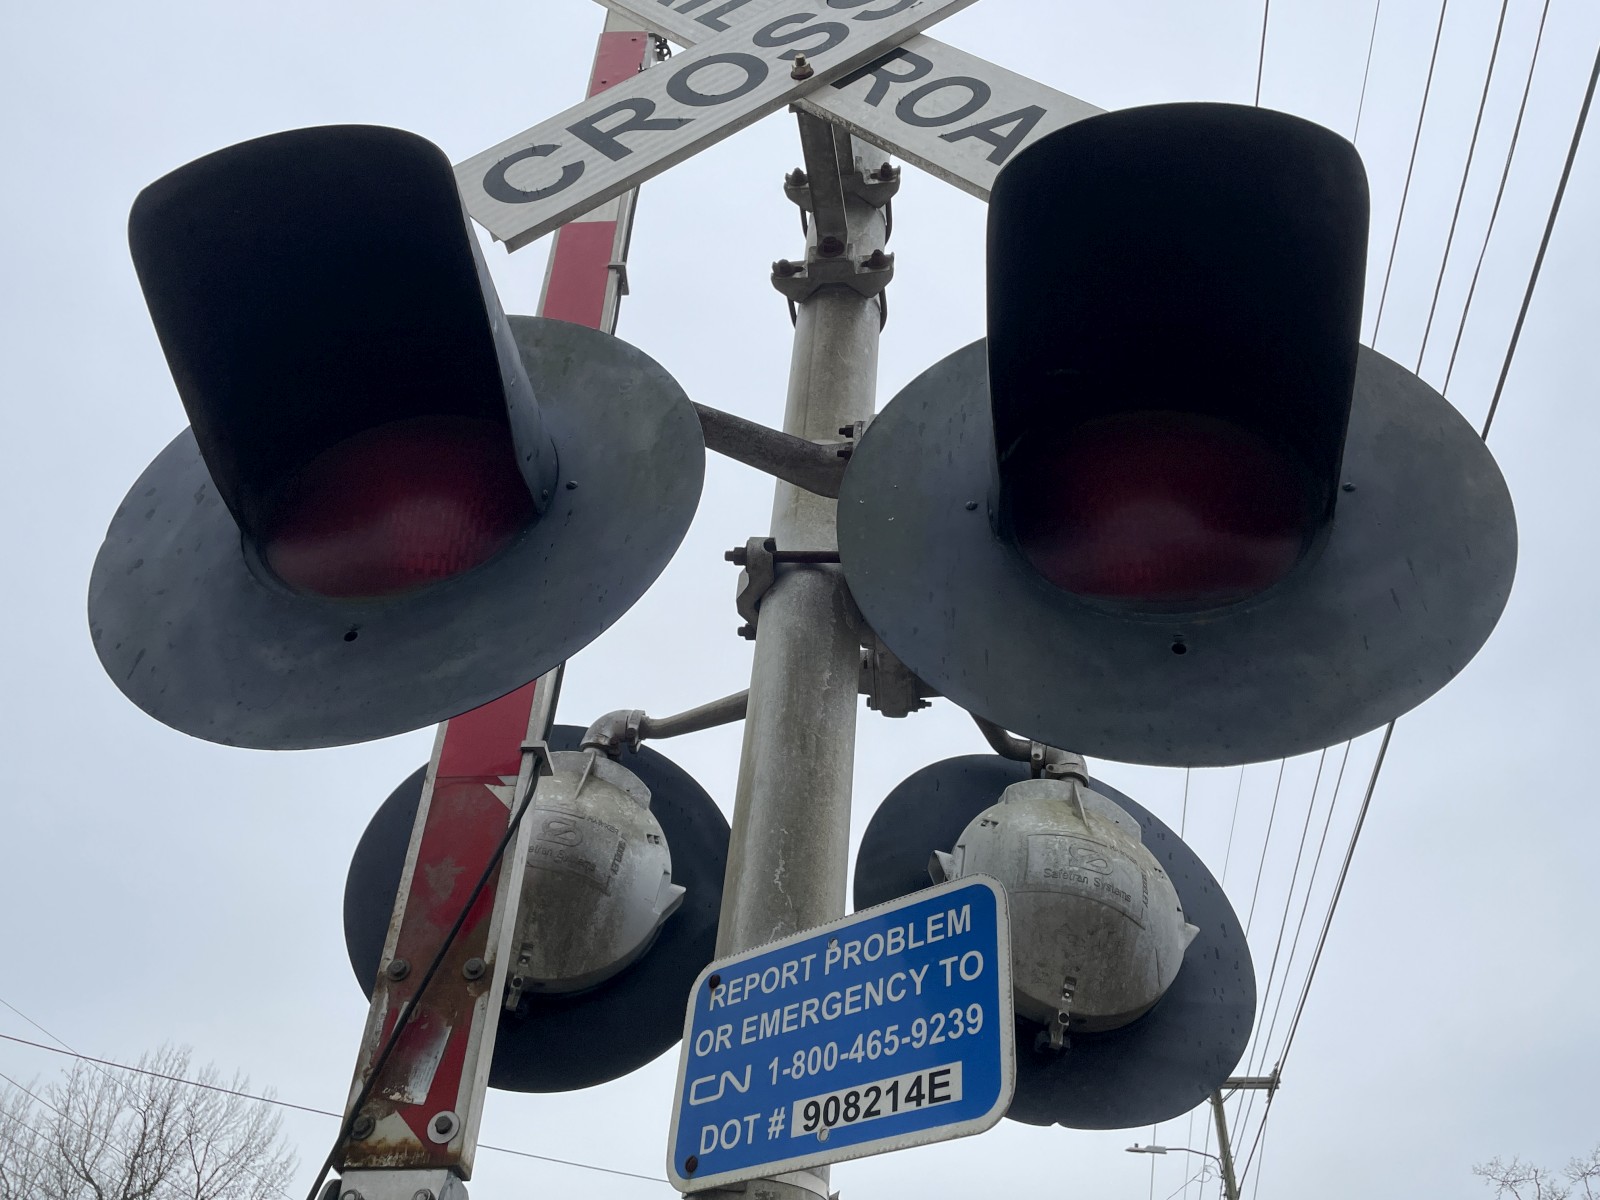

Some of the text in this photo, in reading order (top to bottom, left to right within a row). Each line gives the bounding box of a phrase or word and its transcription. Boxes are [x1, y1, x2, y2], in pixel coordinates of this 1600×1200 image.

[829, 46, 1048, 167] ROA
[1043, 867, 1132, 903] Safetran Systems
[695, 950, 984, 1057] OR EMERGENCY TO
[709, 904, 971, 1011] REPORT PROBLEM
[689, 1003, 983, 1106] CN 1-800-465-9239
[699, 1068, 952, 1155] DOT # 908214E
